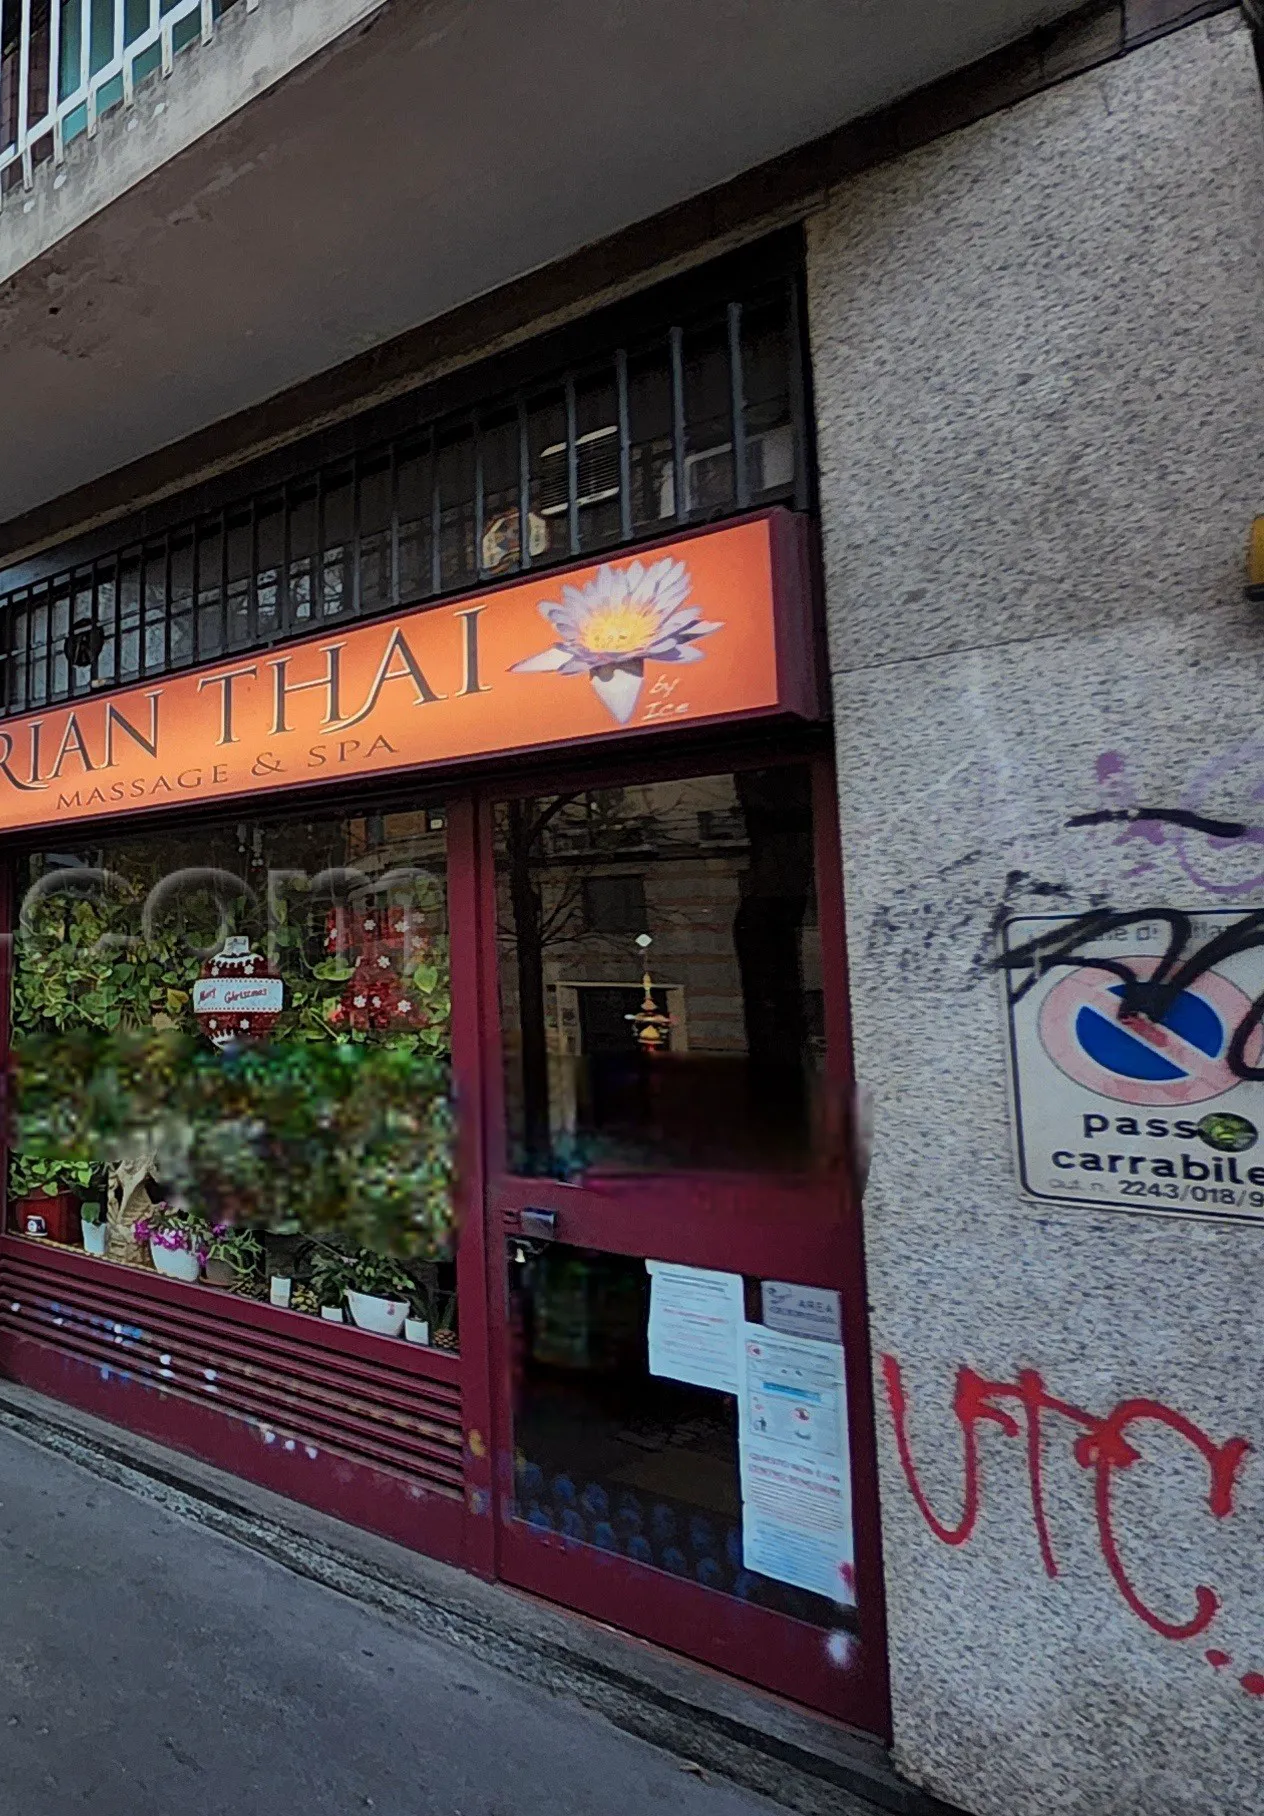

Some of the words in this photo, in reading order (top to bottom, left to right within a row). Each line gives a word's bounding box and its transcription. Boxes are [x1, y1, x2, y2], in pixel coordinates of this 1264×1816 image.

[196, 603, 494, 747] THAI
[648, 673, 681, 698] by
[641, 700, 691, 720] Ice
[55, 763, 229, 811] MASSAGE
[250, 751, 286, 777] &
[306, 733, 400, 768] SPA
[1051, 1150, 1264, 1187] carrabile
